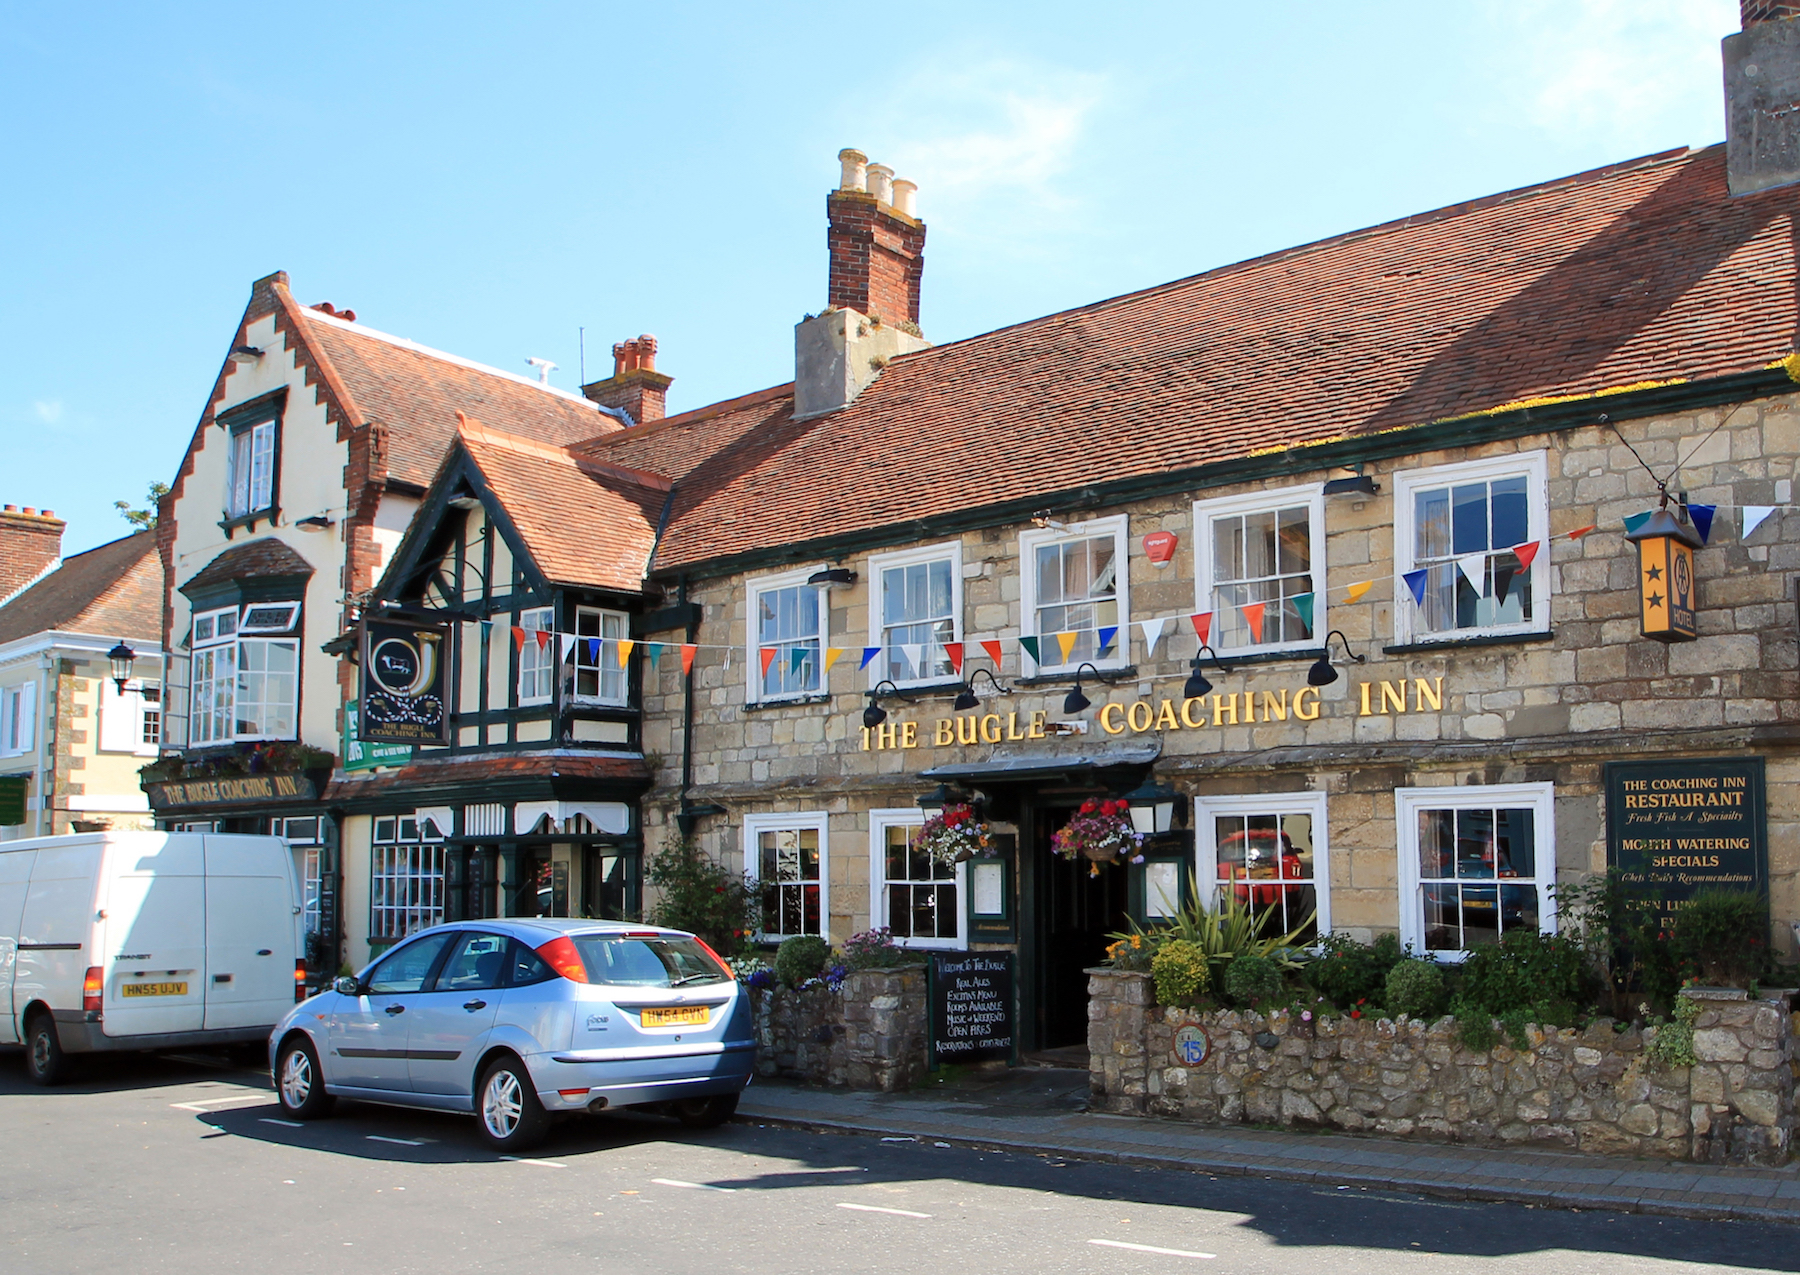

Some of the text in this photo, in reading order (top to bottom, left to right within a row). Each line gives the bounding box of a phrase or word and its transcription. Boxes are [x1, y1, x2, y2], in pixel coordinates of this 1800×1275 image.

[1673, 608, 1694, 629] HOTEL
[859, 676, 1444, 750] THE BUGLE COACHING INN
[370, 728, 436, 739] COACHING INN
[400, 723, 425, 731] BUGLE
[162, 775, 298, 805] THE BUGLE COACHING INN
[1623, 777, 1746, 791] THE COACHING INN
[1625, 791, 1744, 809] RESTAURANT
[1625, 812, 1652, 825] Fresh
[1654, 811, 1677, 824] Fish
[1681, 811, 1694, 822] A
[1676, 838, 1750, 850] WATERING
[1652, 855, 1719, 867] SPECIALS
[1676, 872, 1752, 885] Recommendations
[127, 983, 182, 995] HN55 UJV
[682, 1008, 704, 1022] GVN
[1183, 1041, 1202, 1063] 15
